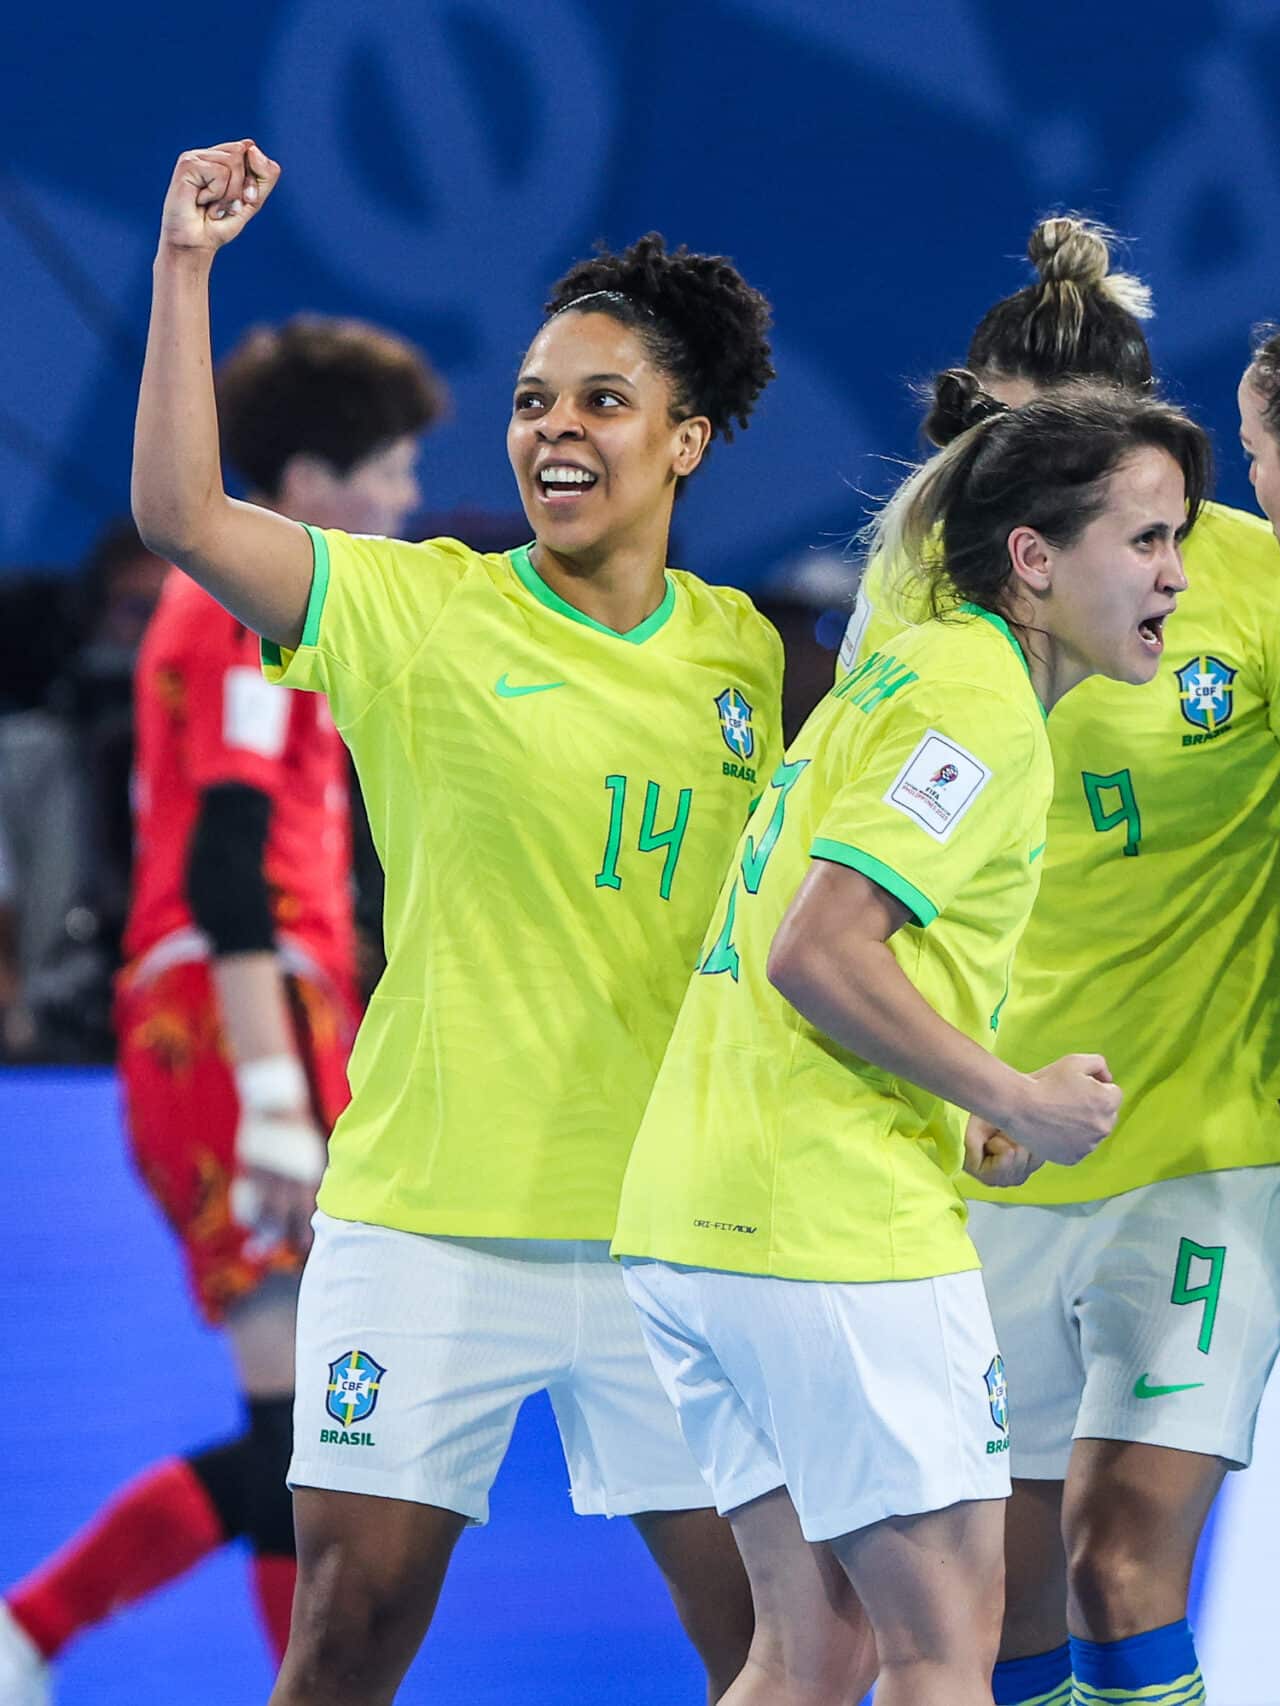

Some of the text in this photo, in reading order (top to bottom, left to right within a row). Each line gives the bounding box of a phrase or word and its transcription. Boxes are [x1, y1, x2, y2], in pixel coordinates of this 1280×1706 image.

[1195, 686, 1217, 697] CBF
[595, 774, 693, 901] 14
[1081, 767, 1142, 857] 9
[1171, 1237, 1227, 1355] 9
[341, 1381, 364, 1391] CBF
[320, 1429, 376, 1447] BRASIL
